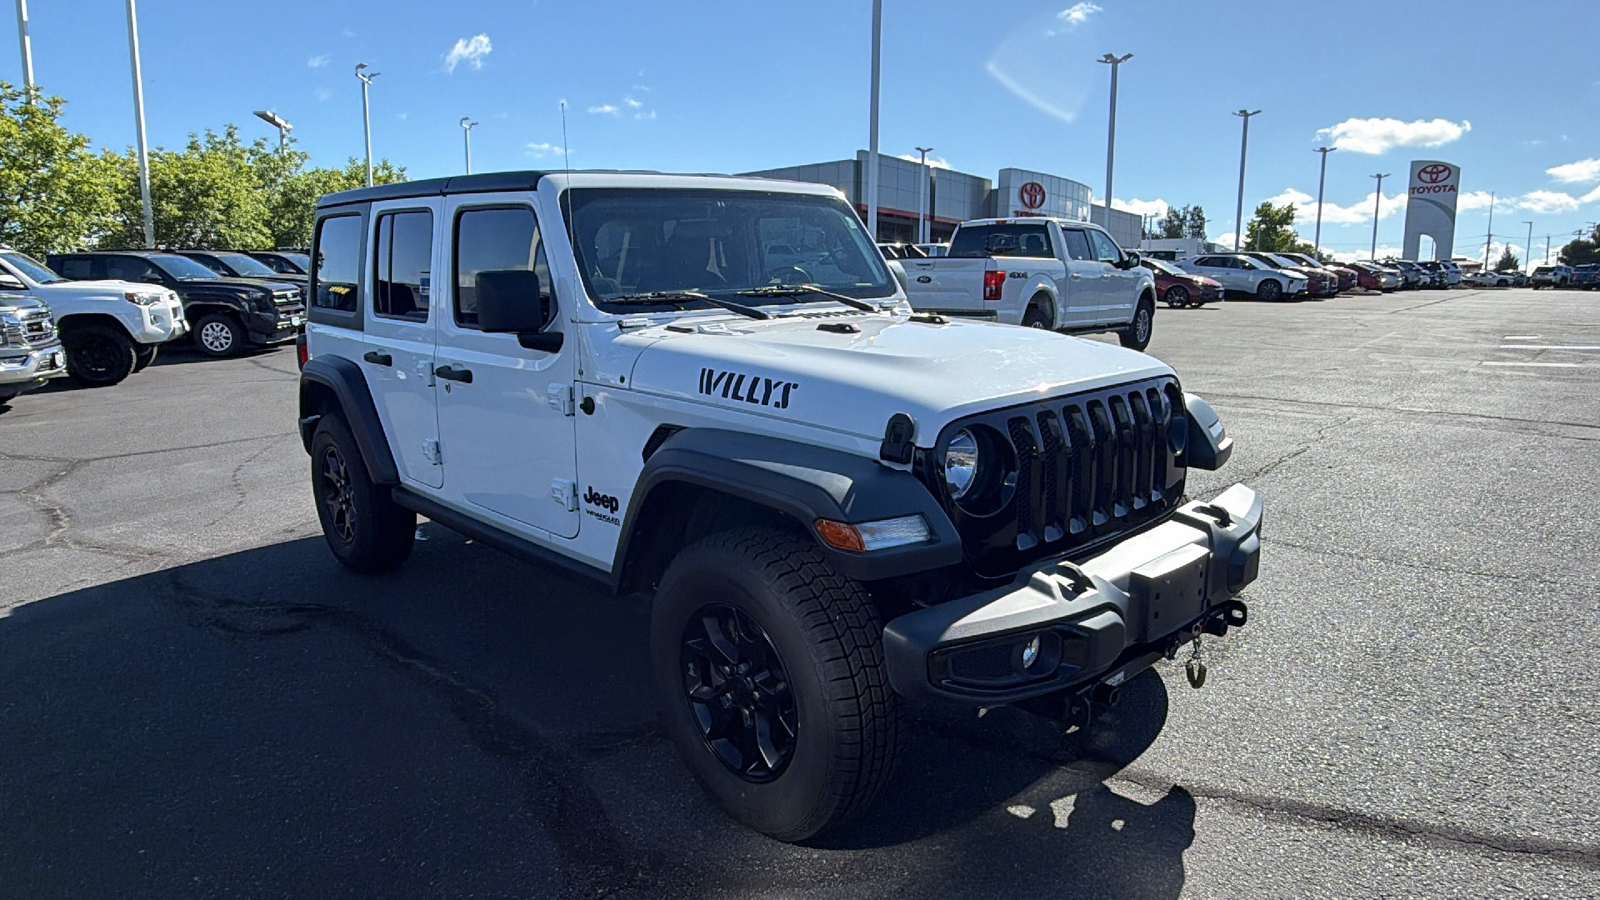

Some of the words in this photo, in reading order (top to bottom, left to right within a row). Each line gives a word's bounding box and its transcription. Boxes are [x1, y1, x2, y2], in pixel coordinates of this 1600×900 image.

[1411, 184, 1456, 195] TOYOTA
[699, 367, 799, 409] WILLYS
[583, 485, 619, 514] Jeep
